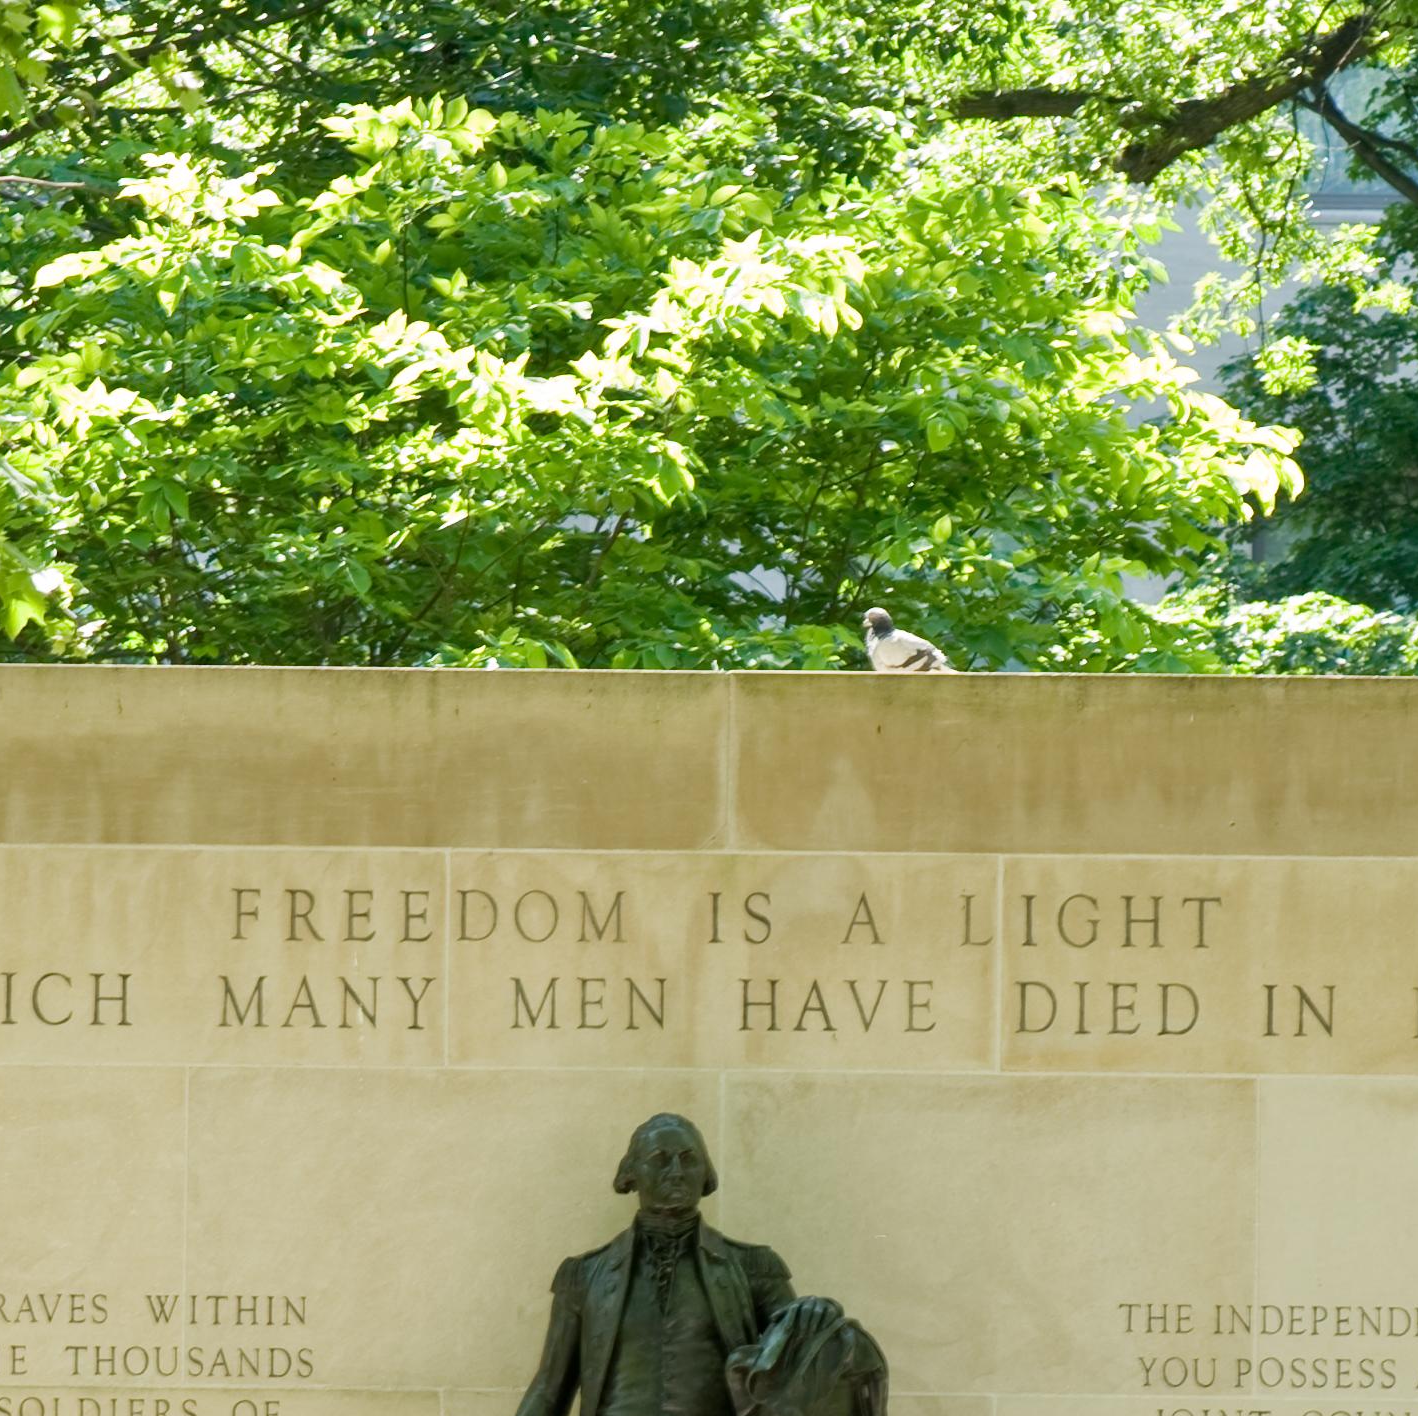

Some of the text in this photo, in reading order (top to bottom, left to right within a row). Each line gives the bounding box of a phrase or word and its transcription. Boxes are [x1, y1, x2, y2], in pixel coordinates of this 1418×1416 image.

[232, 888, 1222, 948] FREEDOM IS A LIGHT
[218, 975, 436, 1030] MANY
[510, 977, 666, 1030] MEN
[739, 979, 936, 1032] HAVE
[1015, 981, 1199, 1036] DIED
[1263, 984, 1335, 1037] IN
[145, 1295, 306, 1326] WITHIN
[1118, 1303, 1193, 1334] THE
[65, 1346, 313, 1378] THOUSANDS
[1138, 1357, 1216, 1389] YOU
[1234, 1357, 1396, 1389] POSSESS
